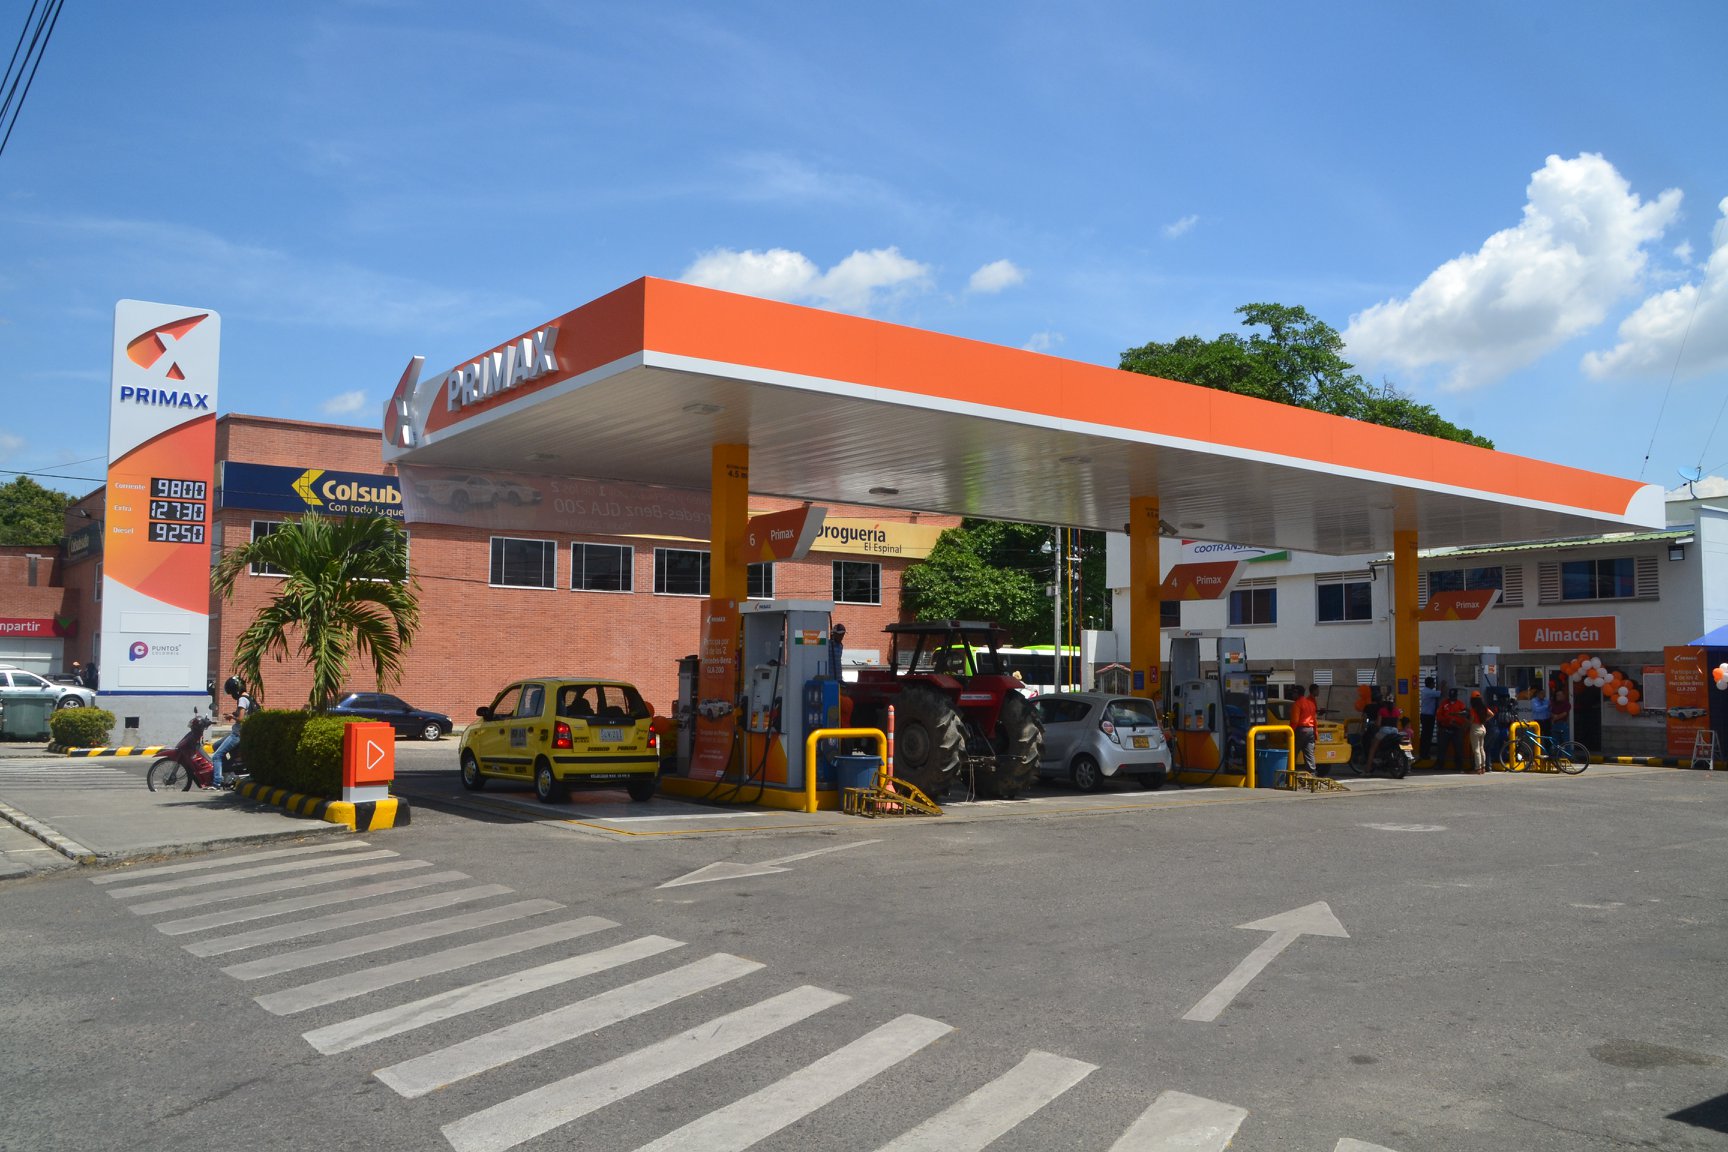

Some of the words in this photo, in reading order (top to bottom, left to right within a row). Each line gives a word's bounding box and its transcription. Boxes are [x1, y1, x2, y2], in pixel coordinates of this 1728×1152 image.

[448, 326, 560, 411] PRIMAX
[120, 386, 208, 409] PRIMAX
[158, 480, 206, 499] 9800
[323, 480, 402, 503] Colsub
[151, 502, 204, 521] 12730
[329, 502, 347, 512] Con
[387, 508, 403, 517] que
[156, 524, 203, 542] 9250
[750, 533, 756, 546] 6
[770, 529, 794, 541] Primax
[864, 543, 872, 551] El
[874, 544, 902, 553] Espinal
[1195, 544, 1252, 553] COOTRAN
[1171, 577, 1178, 588] 4
[1196, 576, 1221, 584] Primax
[1434, 602, 1440, 611] 2
[1456, 601, 1480, 609] Primax
[1535, 626, 1599, 642] Almacén
